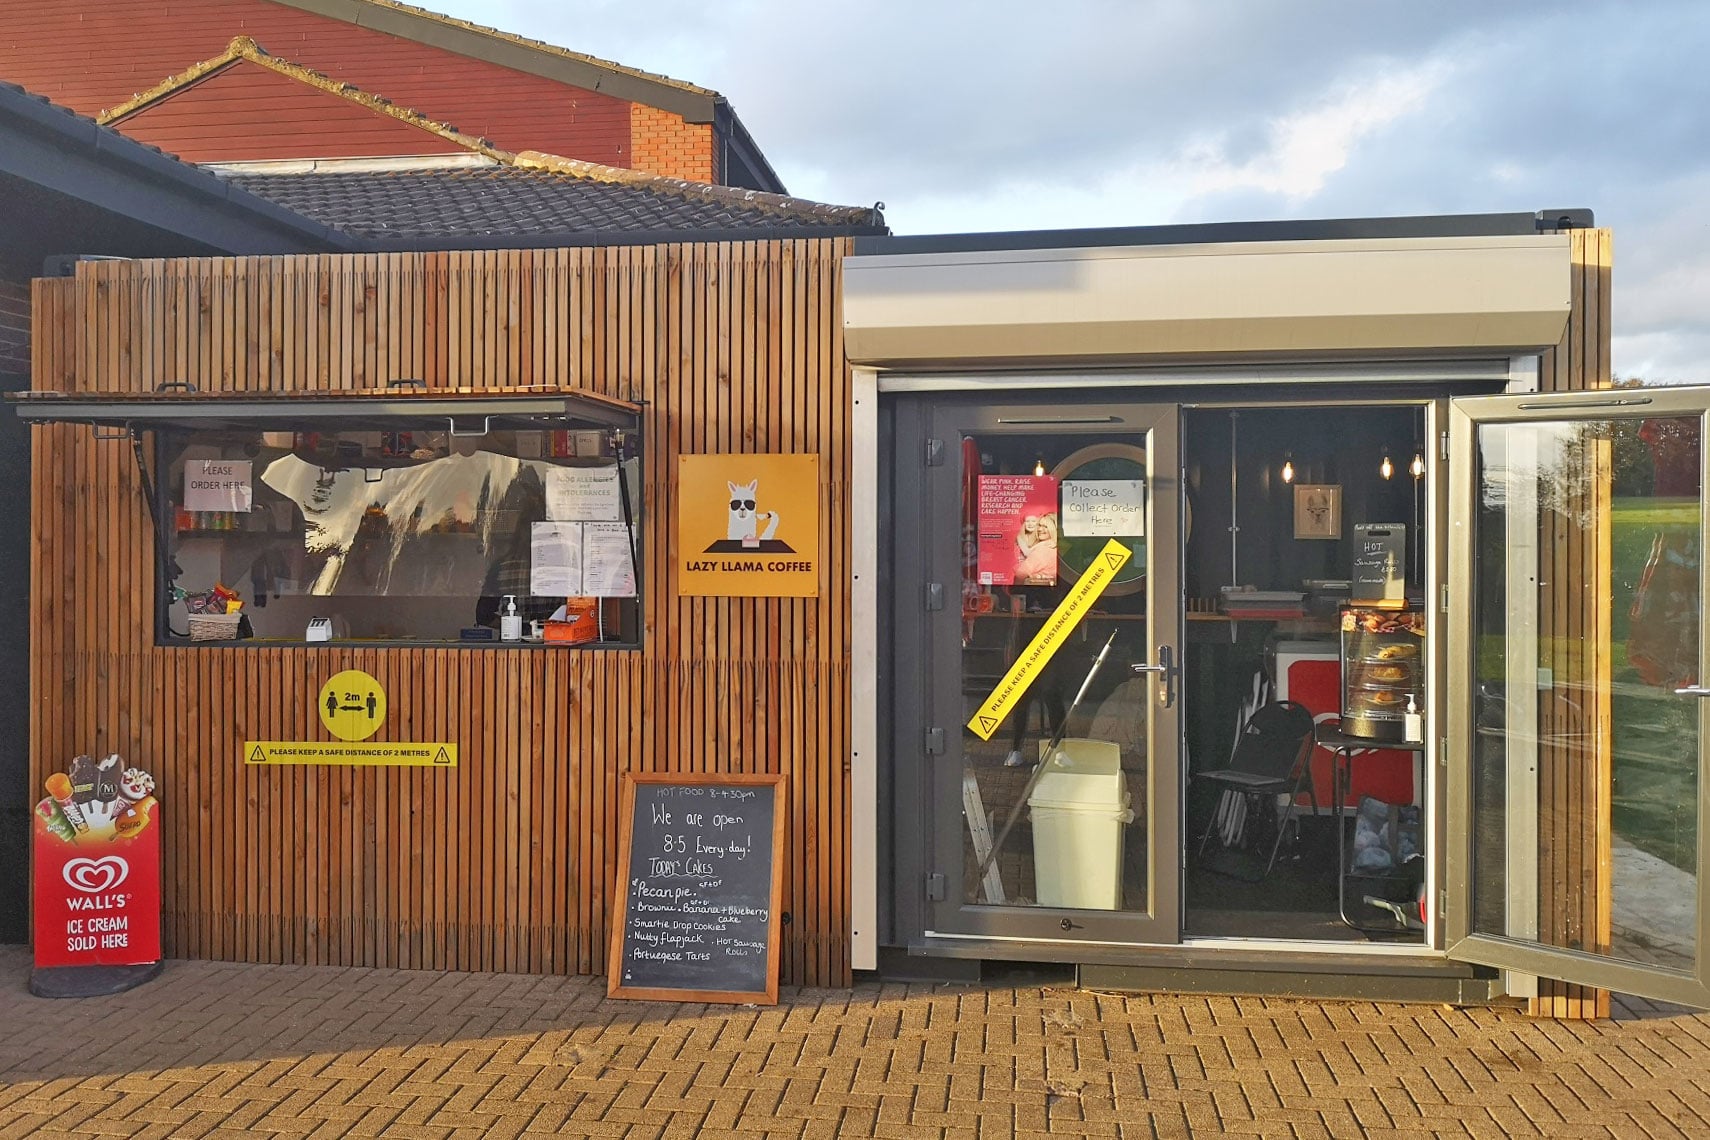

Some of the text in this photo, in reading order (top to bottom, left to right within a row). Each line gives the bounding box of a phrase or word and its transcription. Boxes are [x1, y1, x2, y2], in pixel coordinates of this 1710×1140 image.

[202, 466, 233, 476] PLEASE
[191, 480, 245, 490] ORDER HERE
[1071, 486, 1117, 498] Please
[1069, 503, 1108, 514] Collect
[1091, 516, 1113, 525] Here
[1364, 542, 1384, 552] HOT
[686, 561, 812, 572] LAZY LLAMA COFFEE
[991, 684, 1013, 712] PLEASE
[1011, 667, 1026, 686] KEEP
[1029, 643, 1046, 662] SAFE
[1043, 611, 1071, 645] DISTANCE
[1069, 600, 1079, 611] OF
[1080, 567, 1105, 596] METRES
[344, 692, 360, 701] 2m
[318, 748, 324, 756] A
[656, 786, 676, 798] HOT
[679, 786, 705, 796] FOOD
[651, 803, 744, 831] We are open
[638, 881, 674, 898] Pecan
[66, 894, 126, 911] WALL'S
[637, 901, 676, 912] Brownie
[682, 902, 721, 914] Banana
[728, 906, 769, 922] Blueberry
[67, 916, 128, 934] ICE CREAM
[633, 918, 670, 928] Smartie
[673, 920, 692, 934] Drop
[67, 933, 128, 952] SOLD HERE
[634, 931, 659, 947] Nutty
[685, 951, 711, 960] Tarts
